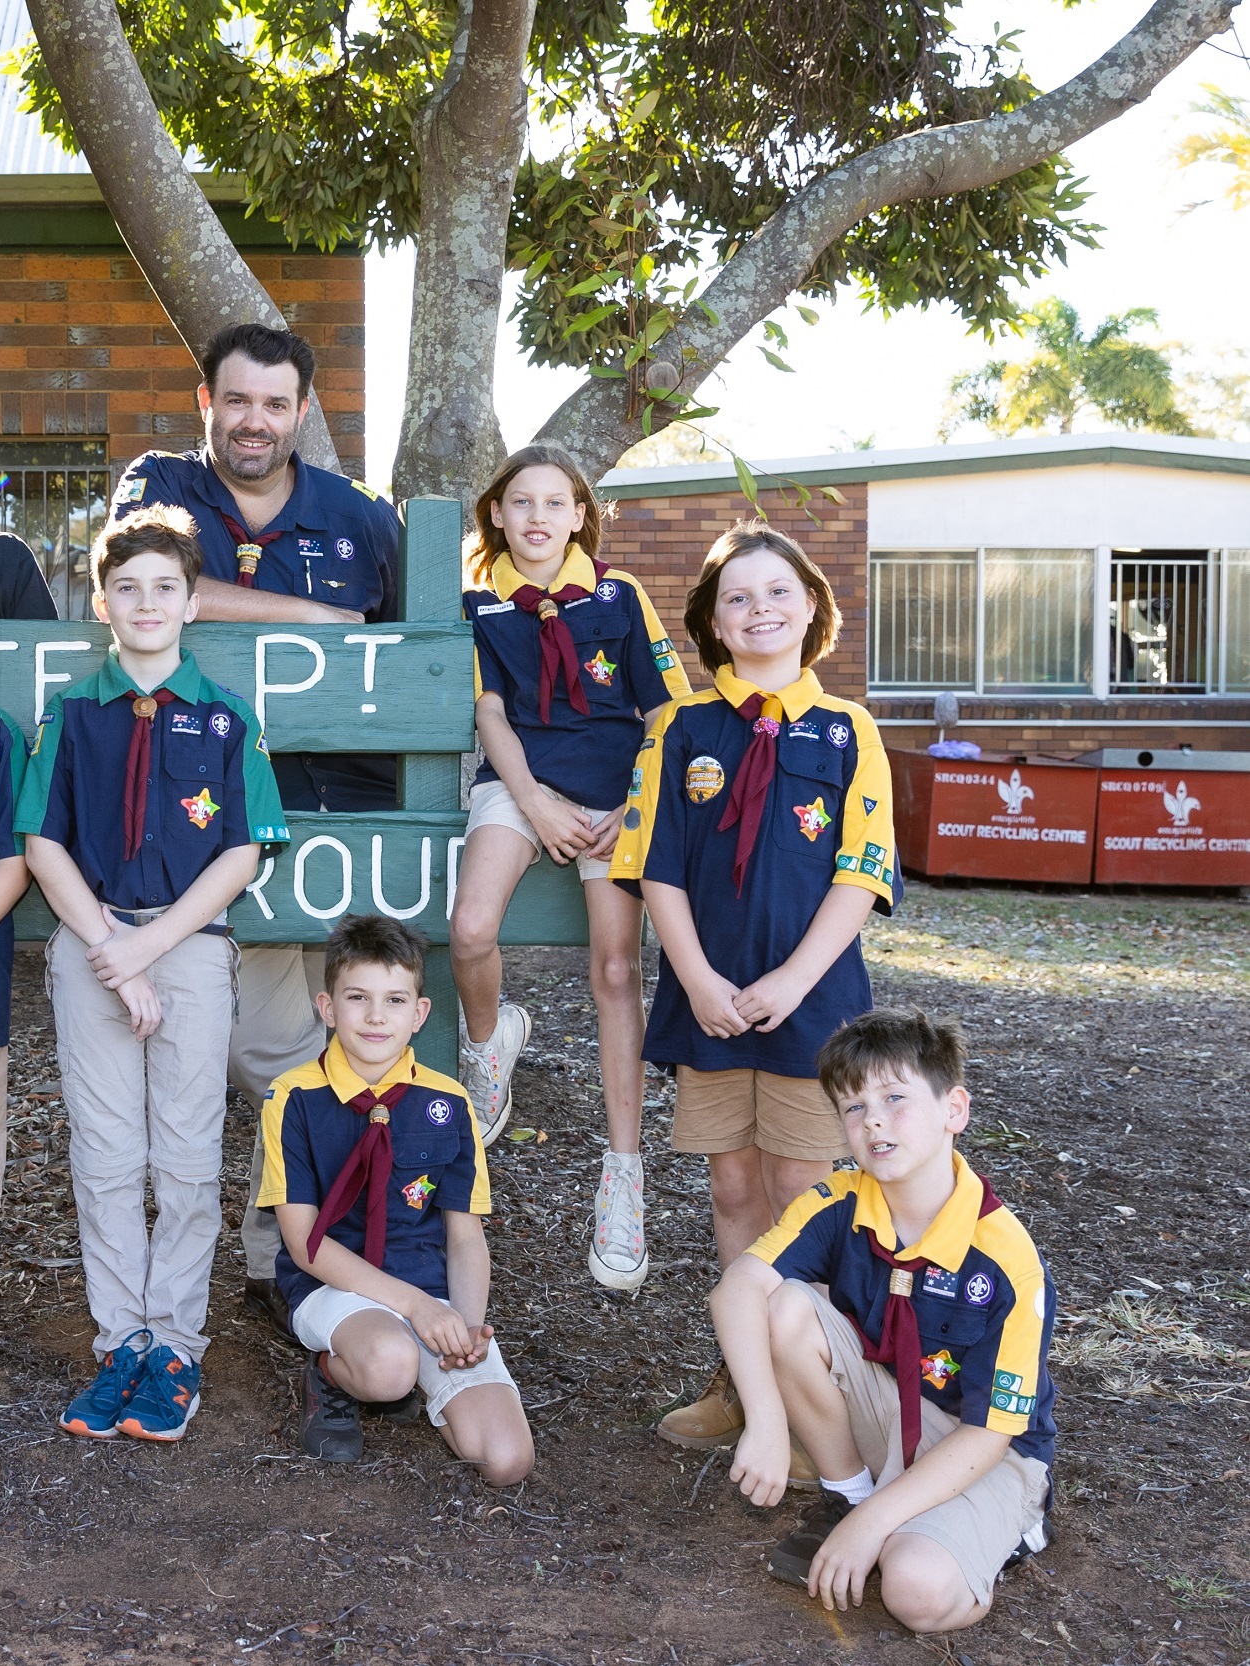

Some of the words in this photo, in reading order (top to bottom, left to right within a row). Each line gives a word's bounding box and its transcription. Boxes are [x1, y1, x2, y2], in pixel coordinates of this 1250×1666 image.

[937, 823, 975, 837] SCOUT
[976, 825, 1039, 842] RECYCLING
[1040, 828, 1087, 844] CENTRE
[1103, 836, 1143, 850] SCOUT
[1143, 837, 1207, 851] RECYCLING
[1208, 838, 1250, 852] CENTRE
